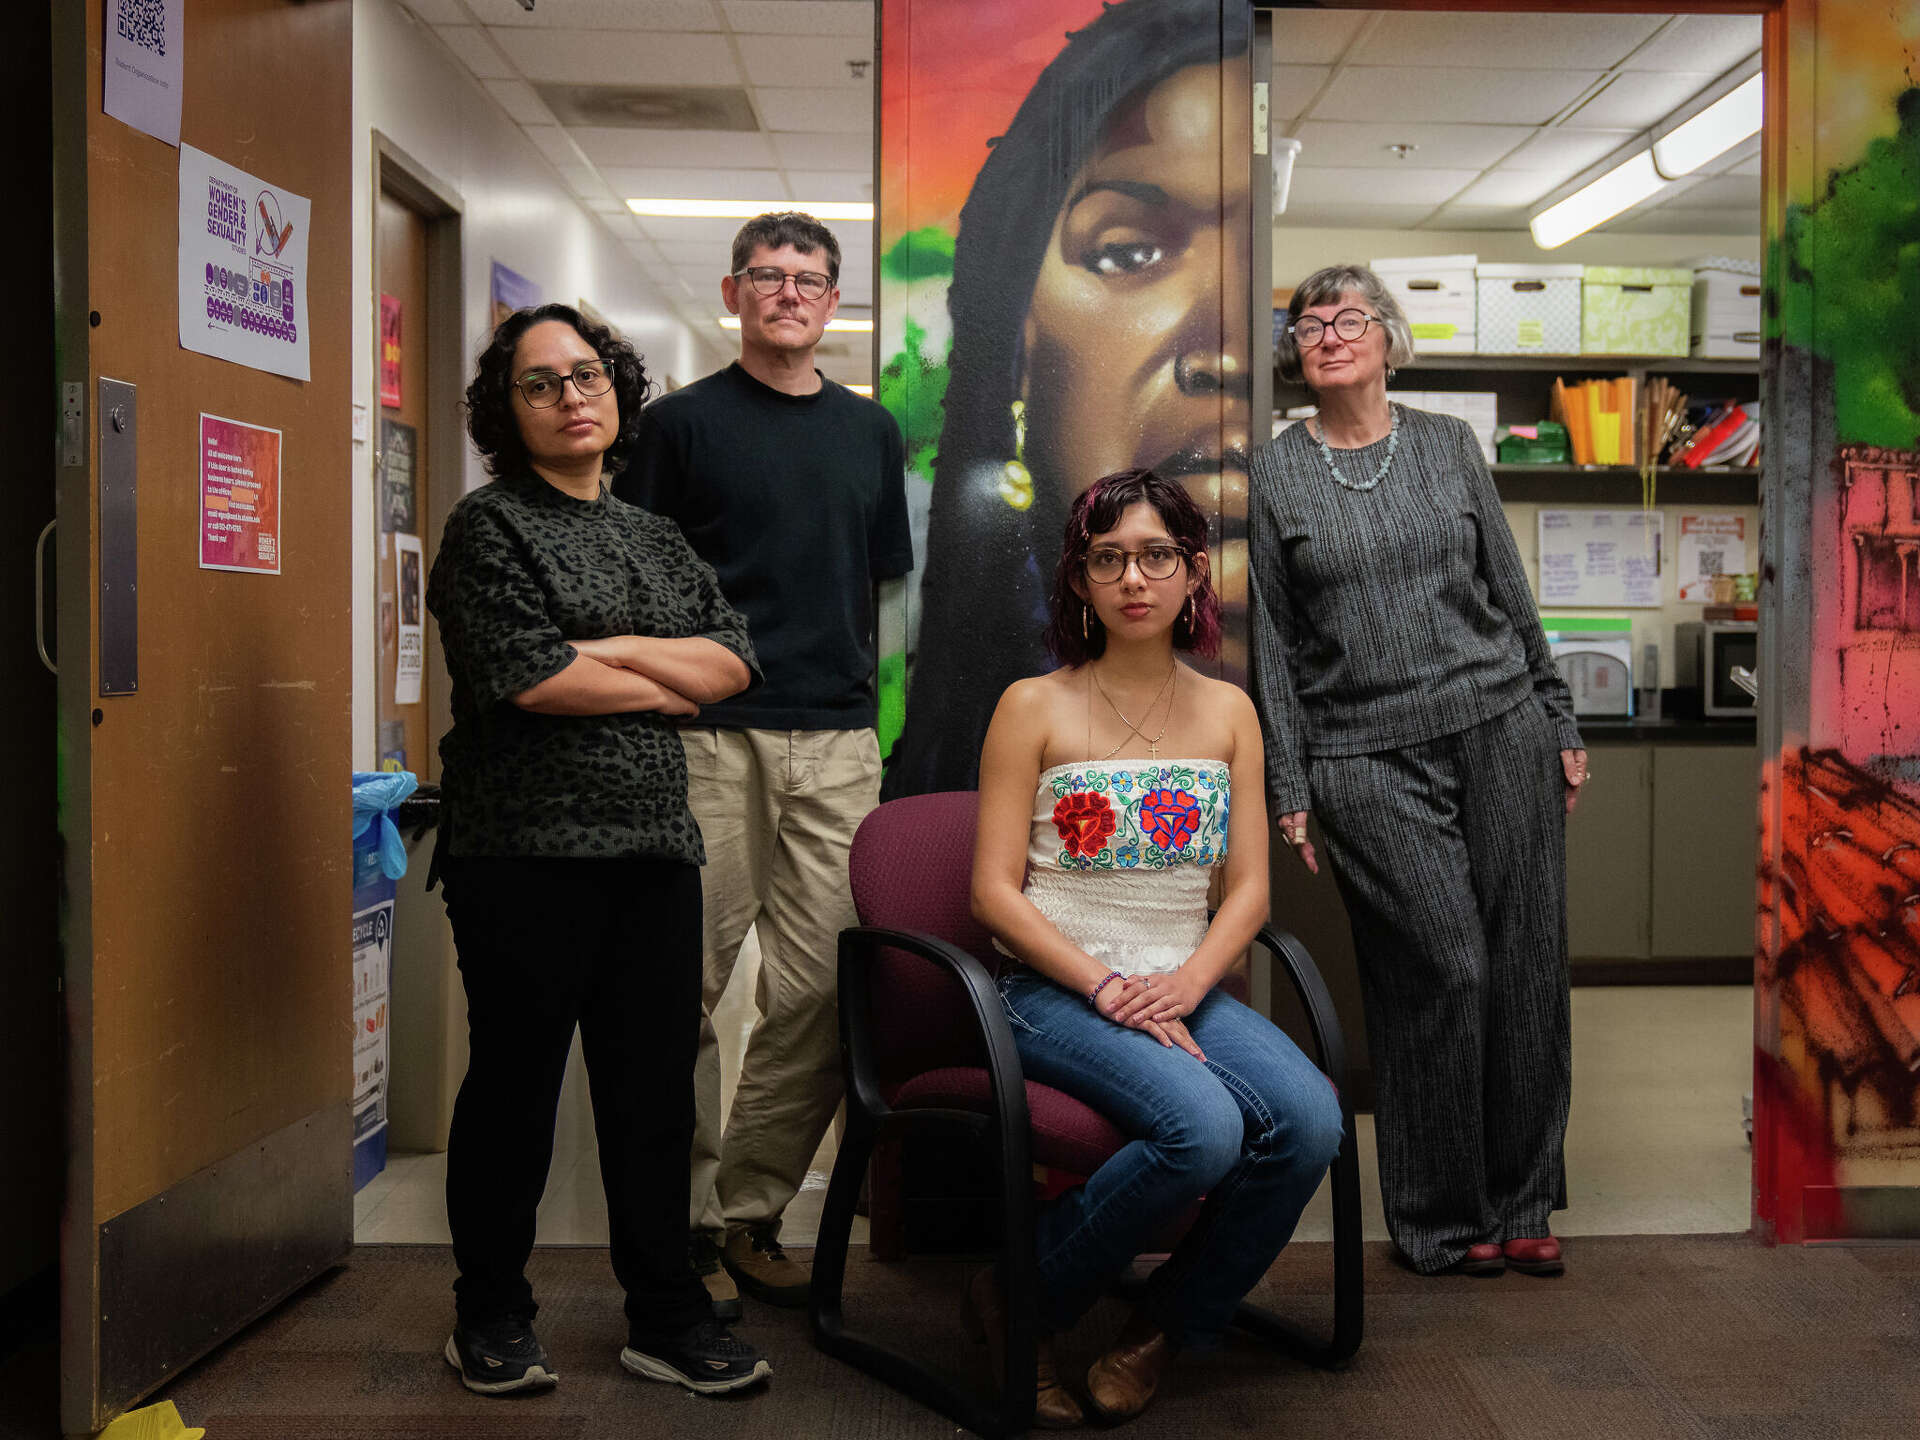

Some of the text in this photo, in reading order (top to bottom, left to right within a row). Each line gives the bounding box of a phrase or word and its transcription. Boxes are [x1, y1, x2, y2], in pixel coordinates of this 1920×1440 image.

[208, 176, 233, 191] DEPARTMENT
[208, 184, 247, 215] WOMEN'S
[208, 201, 247, 231] GENDER &
[207, 218, 247, 247] SEXUALITY
[352, 920, 373, 942] ECYCLE
